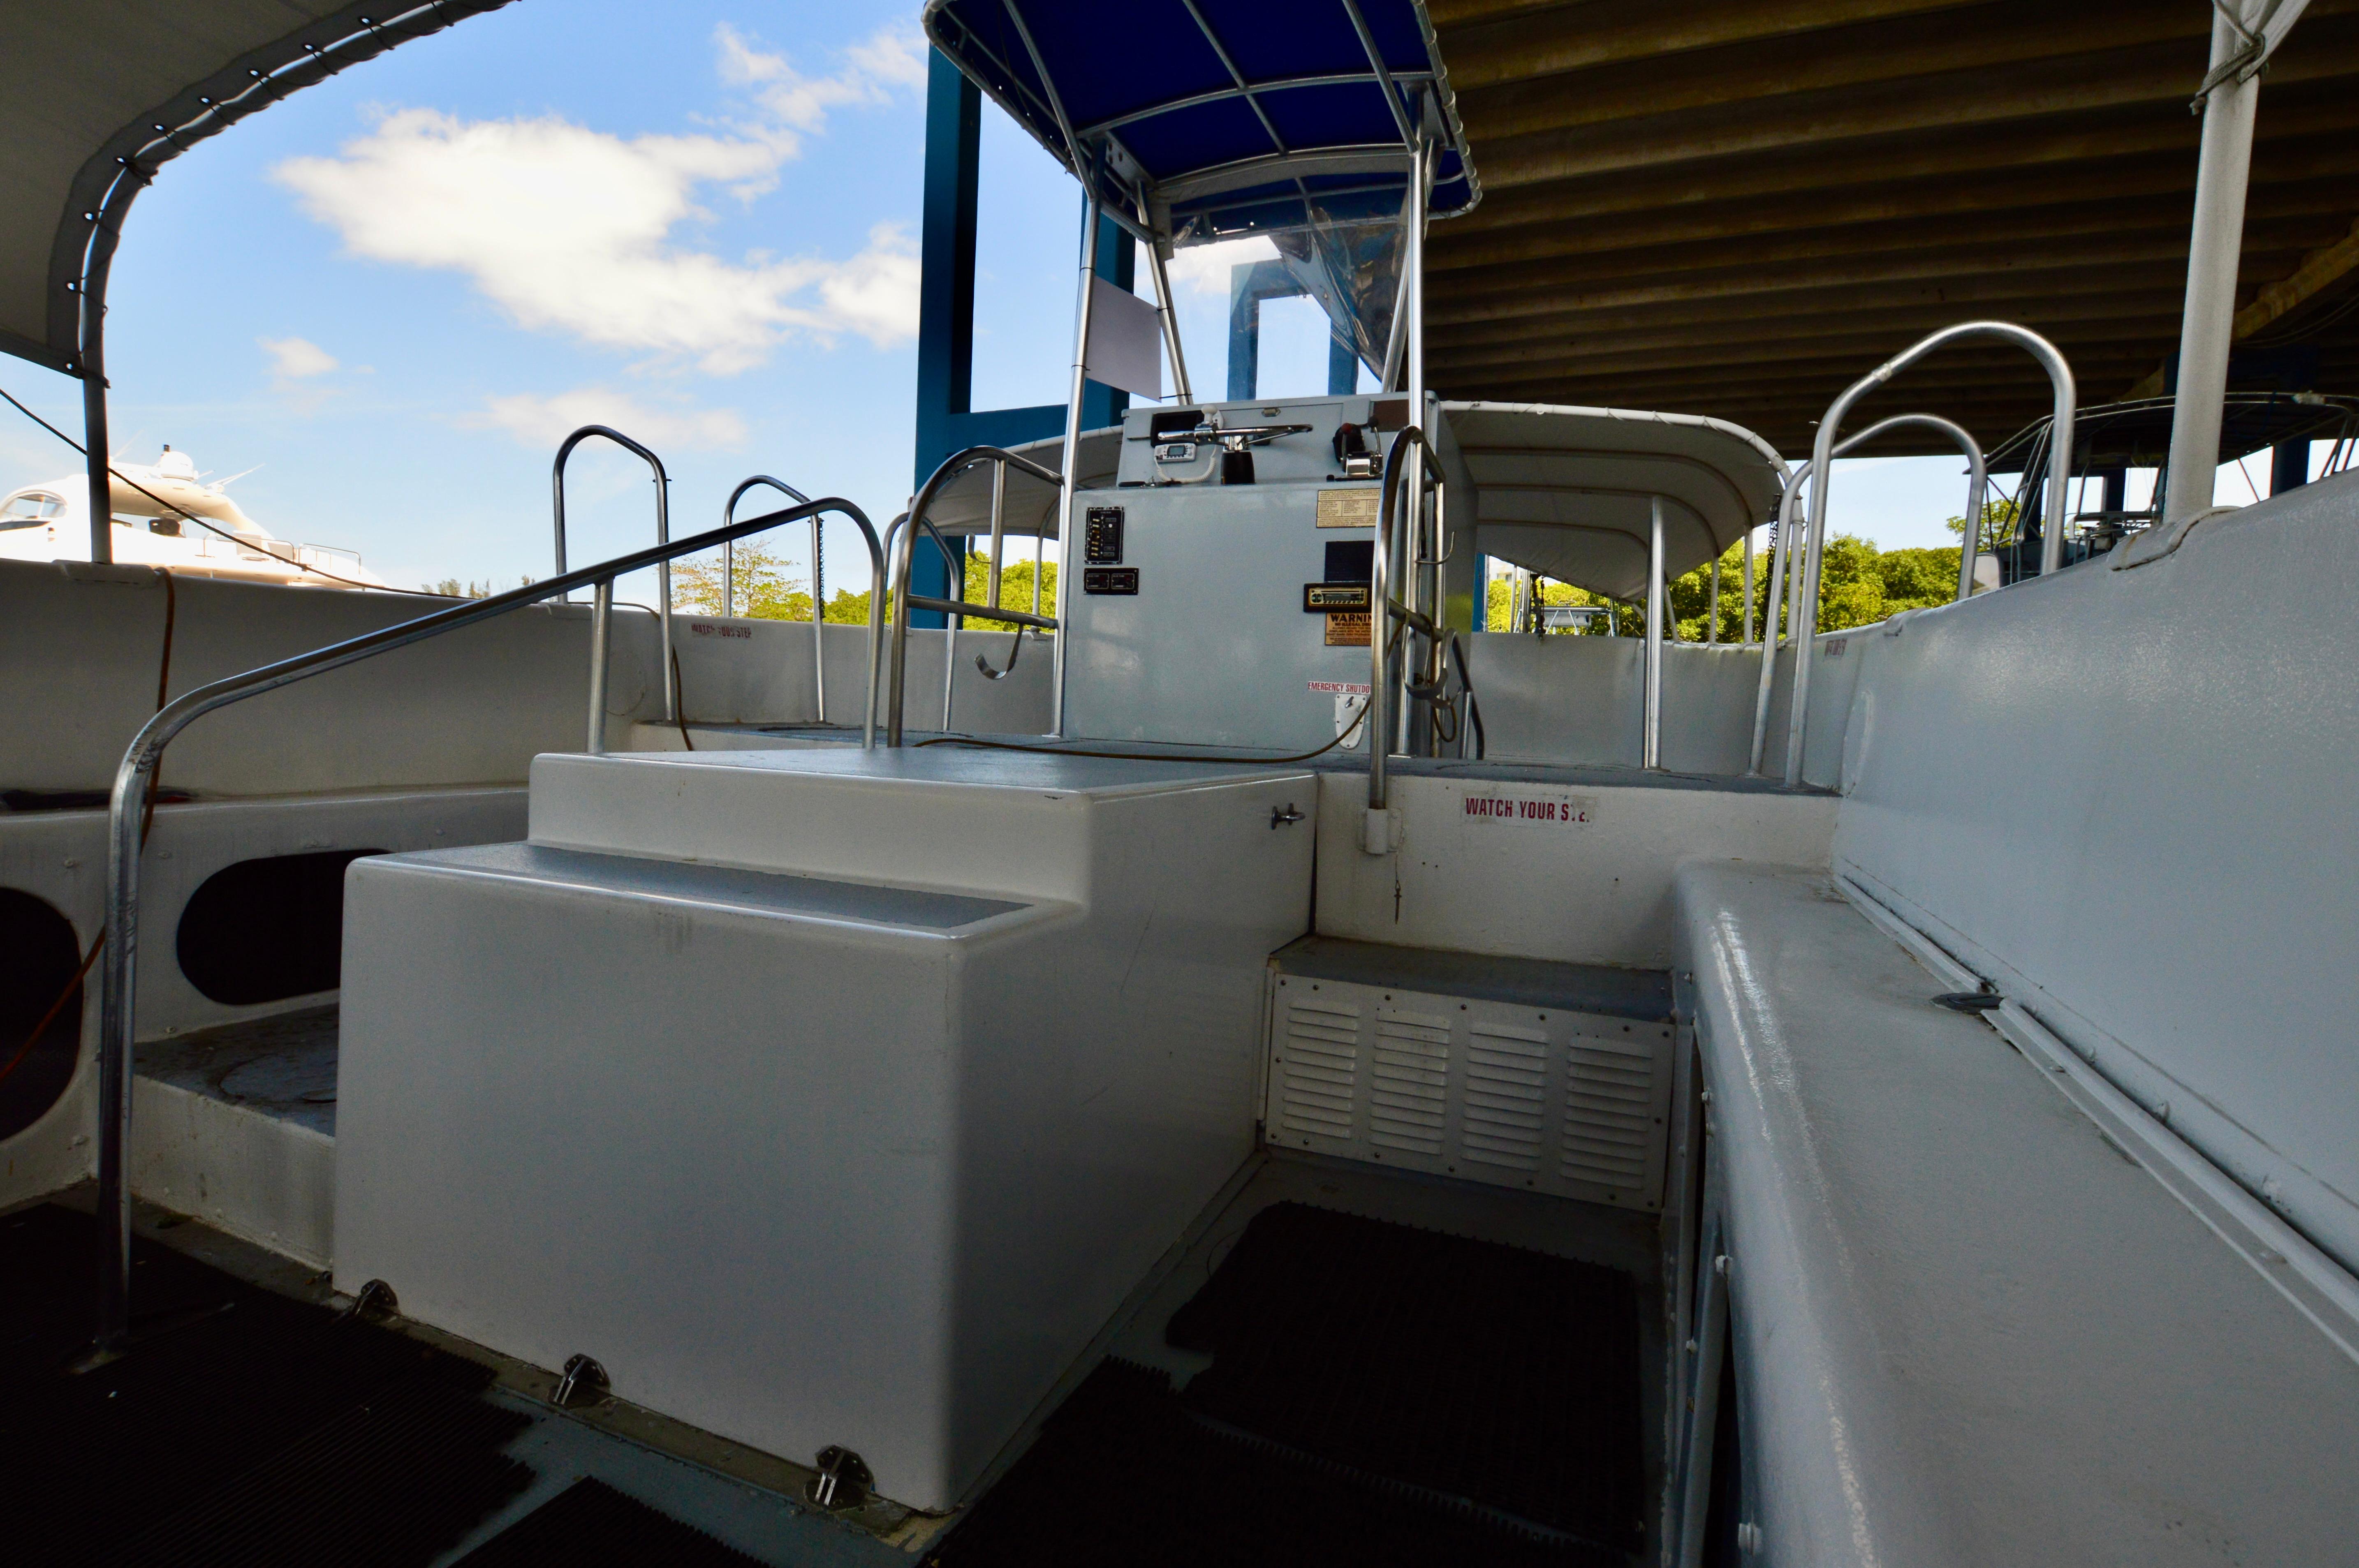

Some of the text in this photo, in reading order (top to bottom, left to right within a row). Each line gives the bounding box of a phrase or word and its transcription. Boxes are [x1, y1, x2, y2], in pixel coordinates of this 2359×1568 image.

[692, 624, 715, 634] WATC
[1308, 682, 1370, 694] EMERGENCY SHUTDO
[1466, 798, 1513, 817] WATCH
[1520, 801, 1555, 820] YOUR
